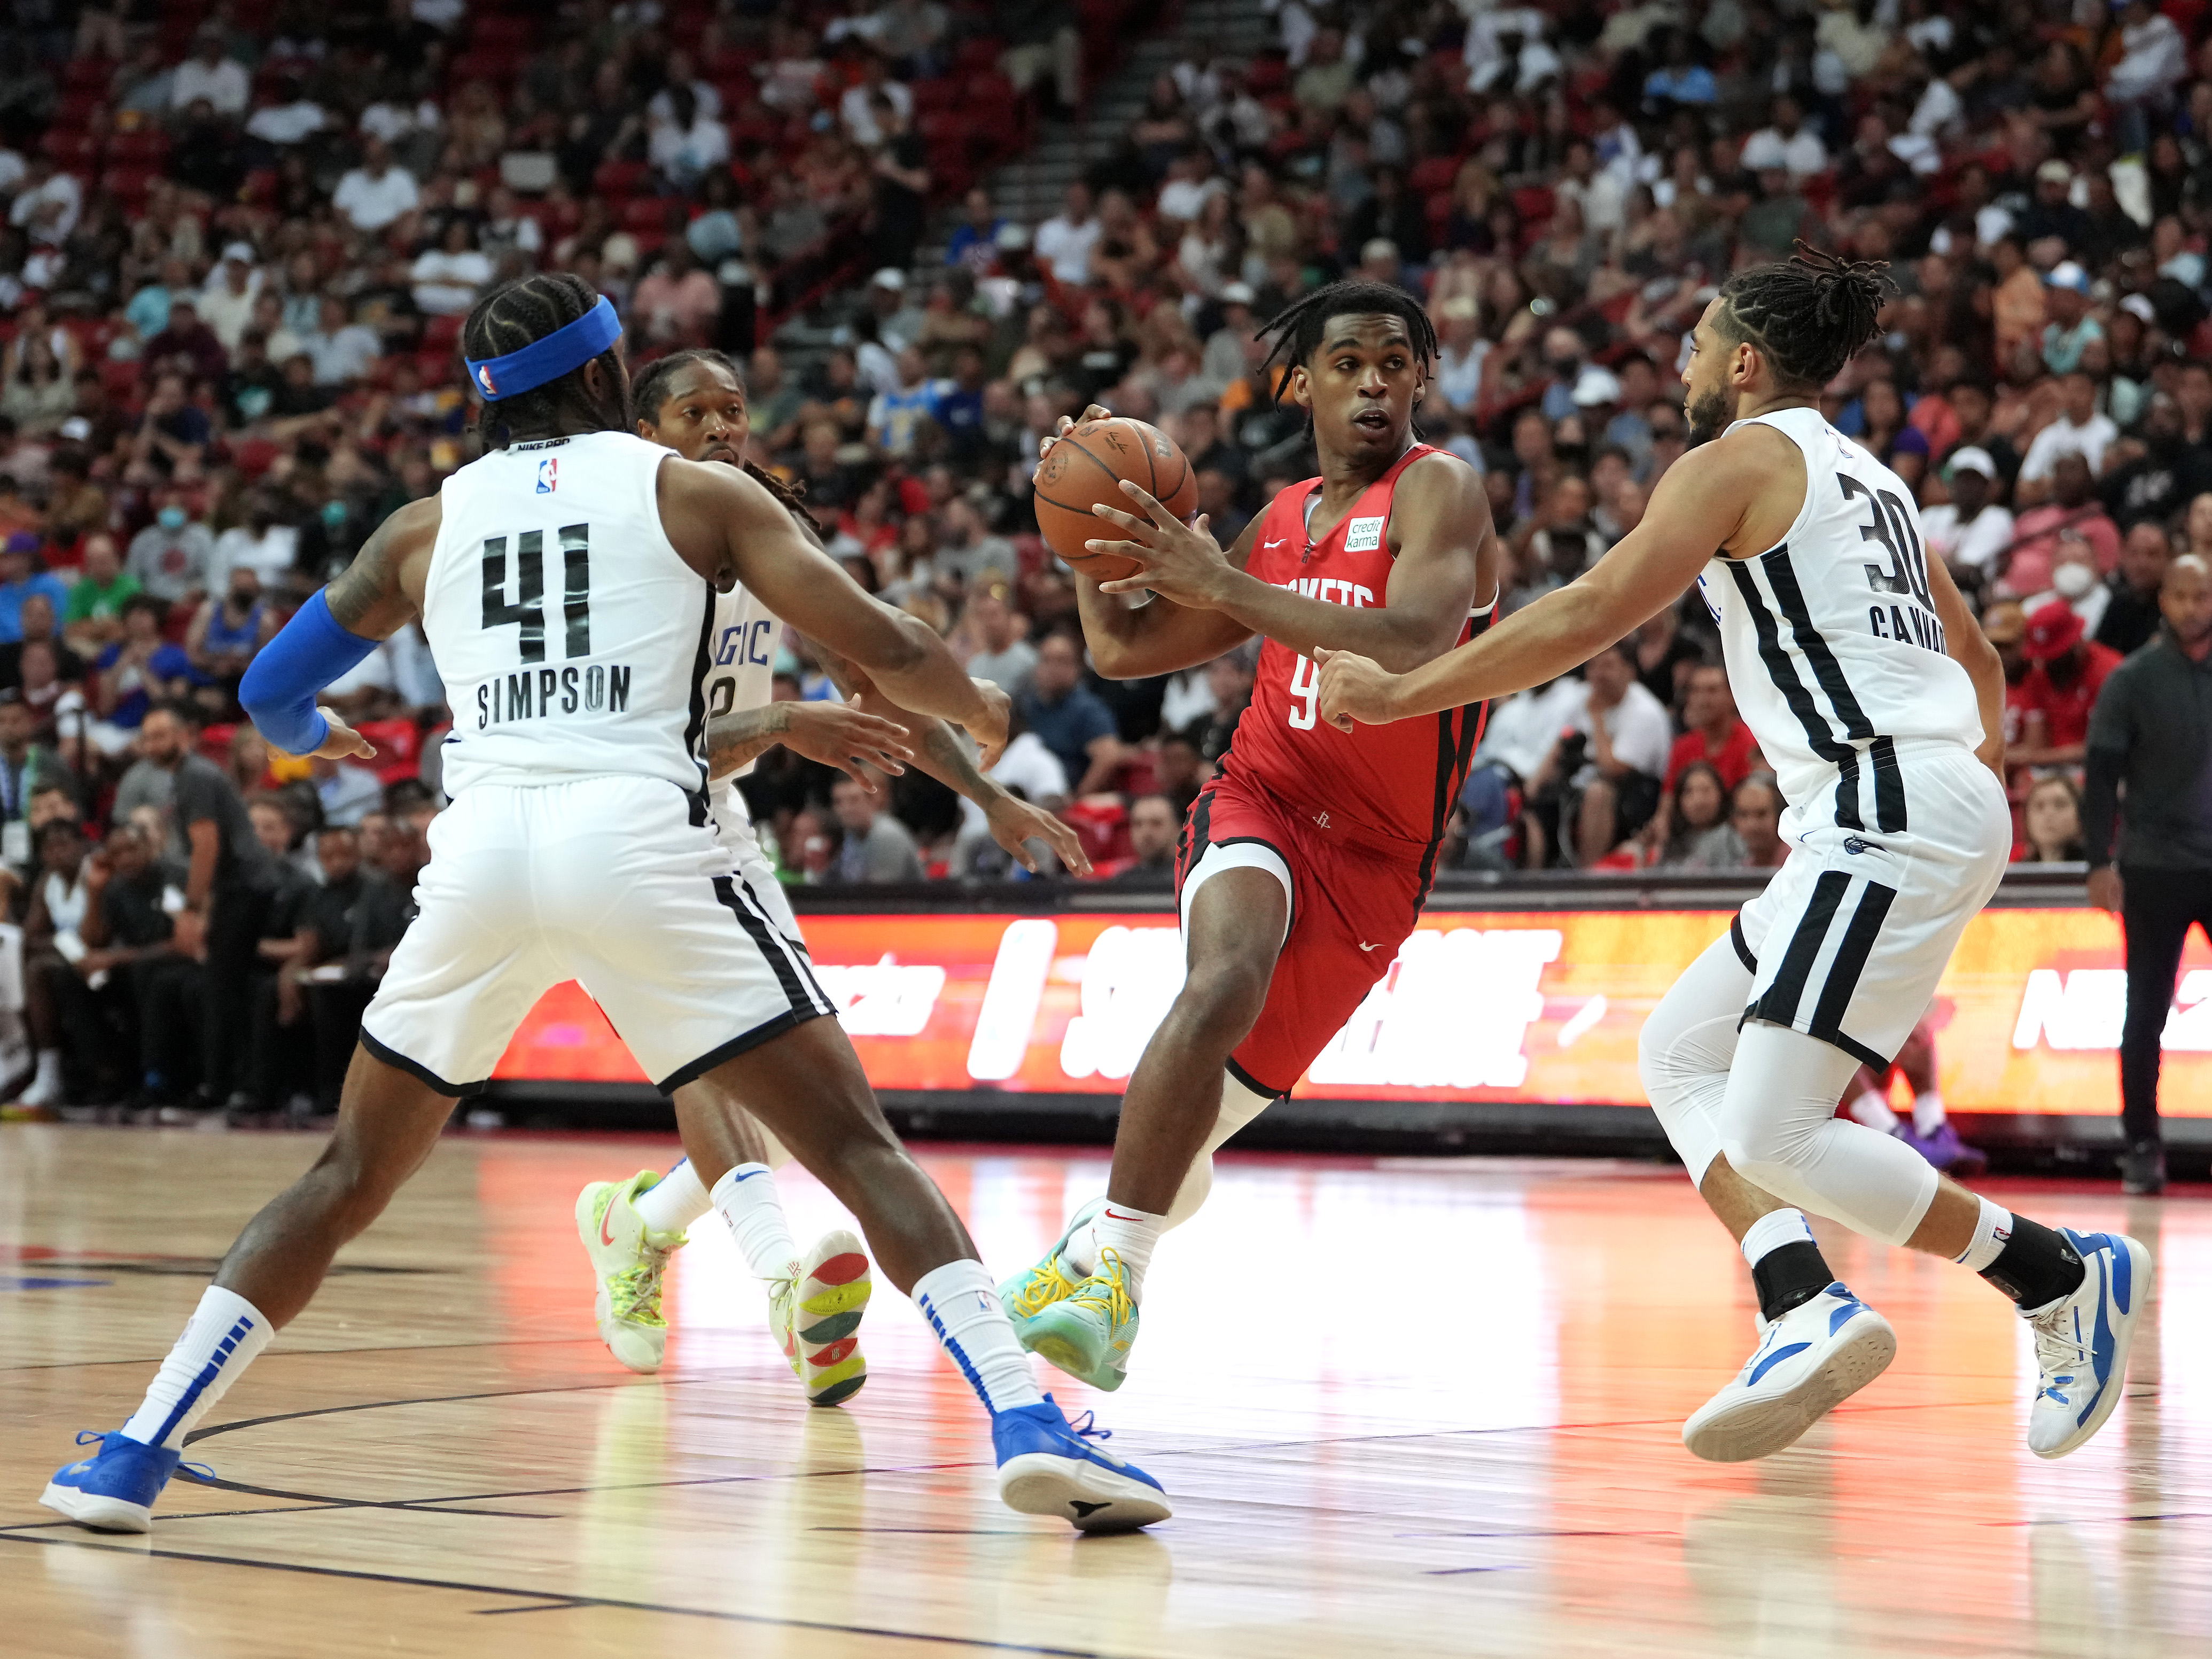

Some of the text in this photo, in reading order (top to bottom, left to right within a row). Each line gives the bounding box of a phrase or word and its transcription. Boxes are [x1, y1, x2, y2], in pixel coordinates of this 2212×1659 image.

[518, 442, 543, 451] NIKE
[1346, 535, 1377, 548] karma
[1353, 520, 1380, 533] credit
[1836, 472, 1935, 614] 30
[482, 523, 590, 664] 41
[716, 620, 770, 666] GIC
[478, 665, 631, 730] SIMPSON
[1288, 653, 1319, 730] 9
